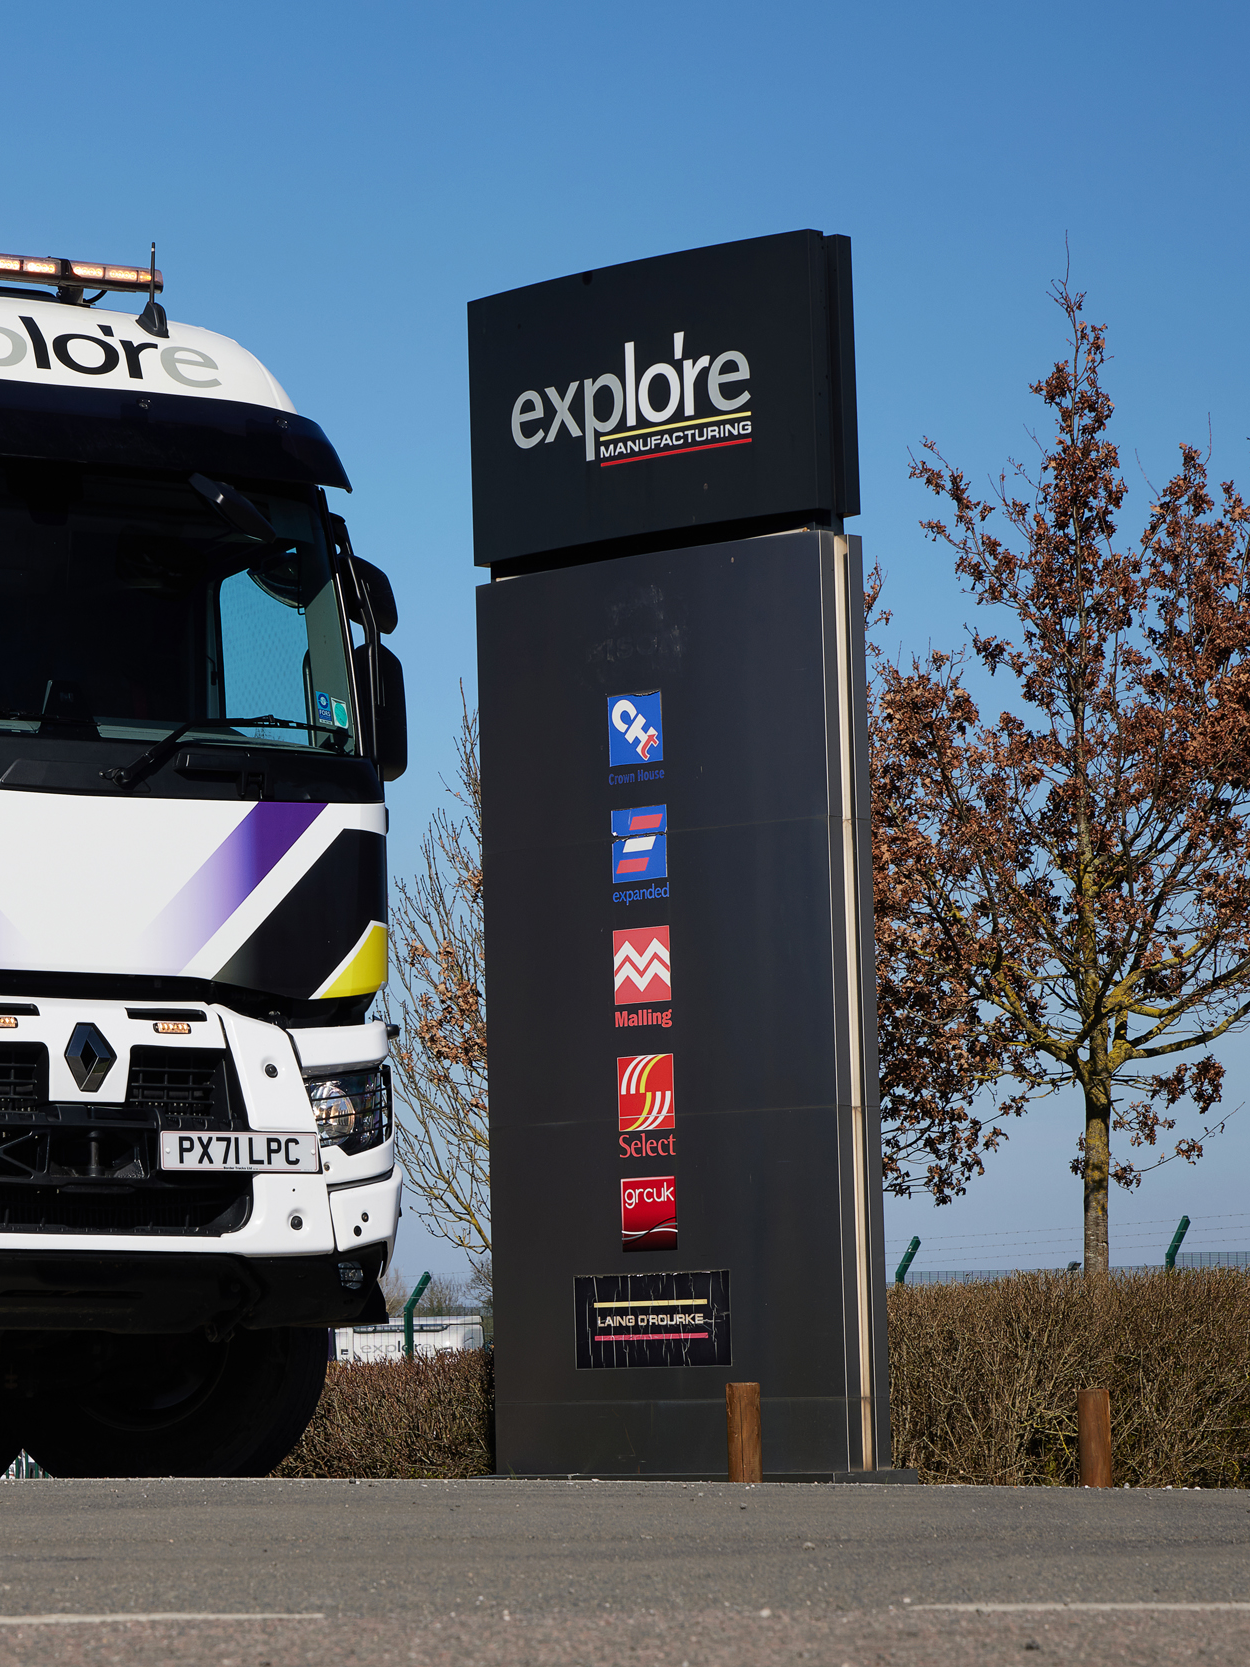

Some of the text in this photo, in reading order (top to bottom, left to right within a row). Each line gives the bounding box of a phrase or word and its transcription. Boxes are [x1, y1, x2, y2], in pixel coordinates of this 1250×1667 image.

[511, 331, 752, 462] explore
[600, 420, 752, 459] MANUFACTURING
[608, 767, 665, 786] Crown House
[612, 882, 669, 906] expanded
[614, 1008, 673, 1028] Malling
[178, 1136, 301, 1166] PX71 LPC
[618, 1133, 677, 1158] Select
[624, 1181, 674, 1209] grcuk
[597, 1313, 704, 1327] LAING O'ROURKE
